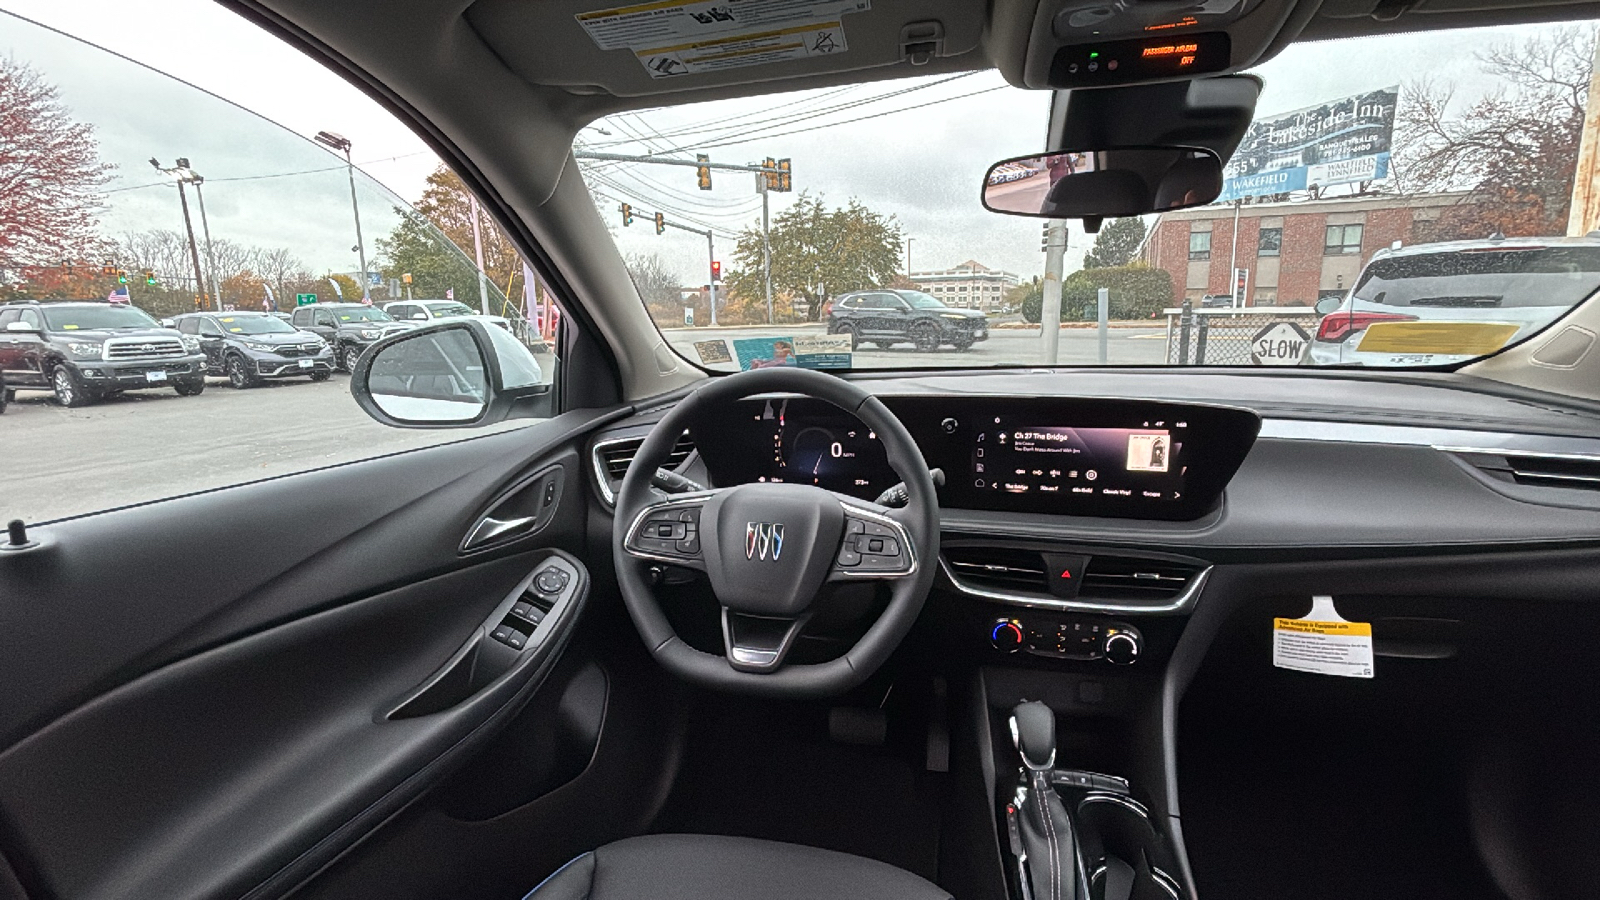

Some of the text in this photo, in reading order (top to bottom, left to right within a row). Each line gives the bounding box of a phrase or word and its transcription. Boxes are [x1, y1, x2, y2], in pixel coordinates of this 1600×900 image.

[1180, 56, 1195, 65] OFF
[1267, 108, 1346, 145] Lakeside
[1352, 99, 1384, 119] Inn
[1293, 111, 1317, 127] The
[1327, 158, 1376, 172] WAKEFIELD
[1328, 165, 1374, 178] LYNNFIELD
[1232, 172, 1288, 190] WAKEFIELD
[1258, 340, 1303, 358] SLOW
[1046, 433, 1068, 442] Bridge
[831, 442, 842, 458] 0
